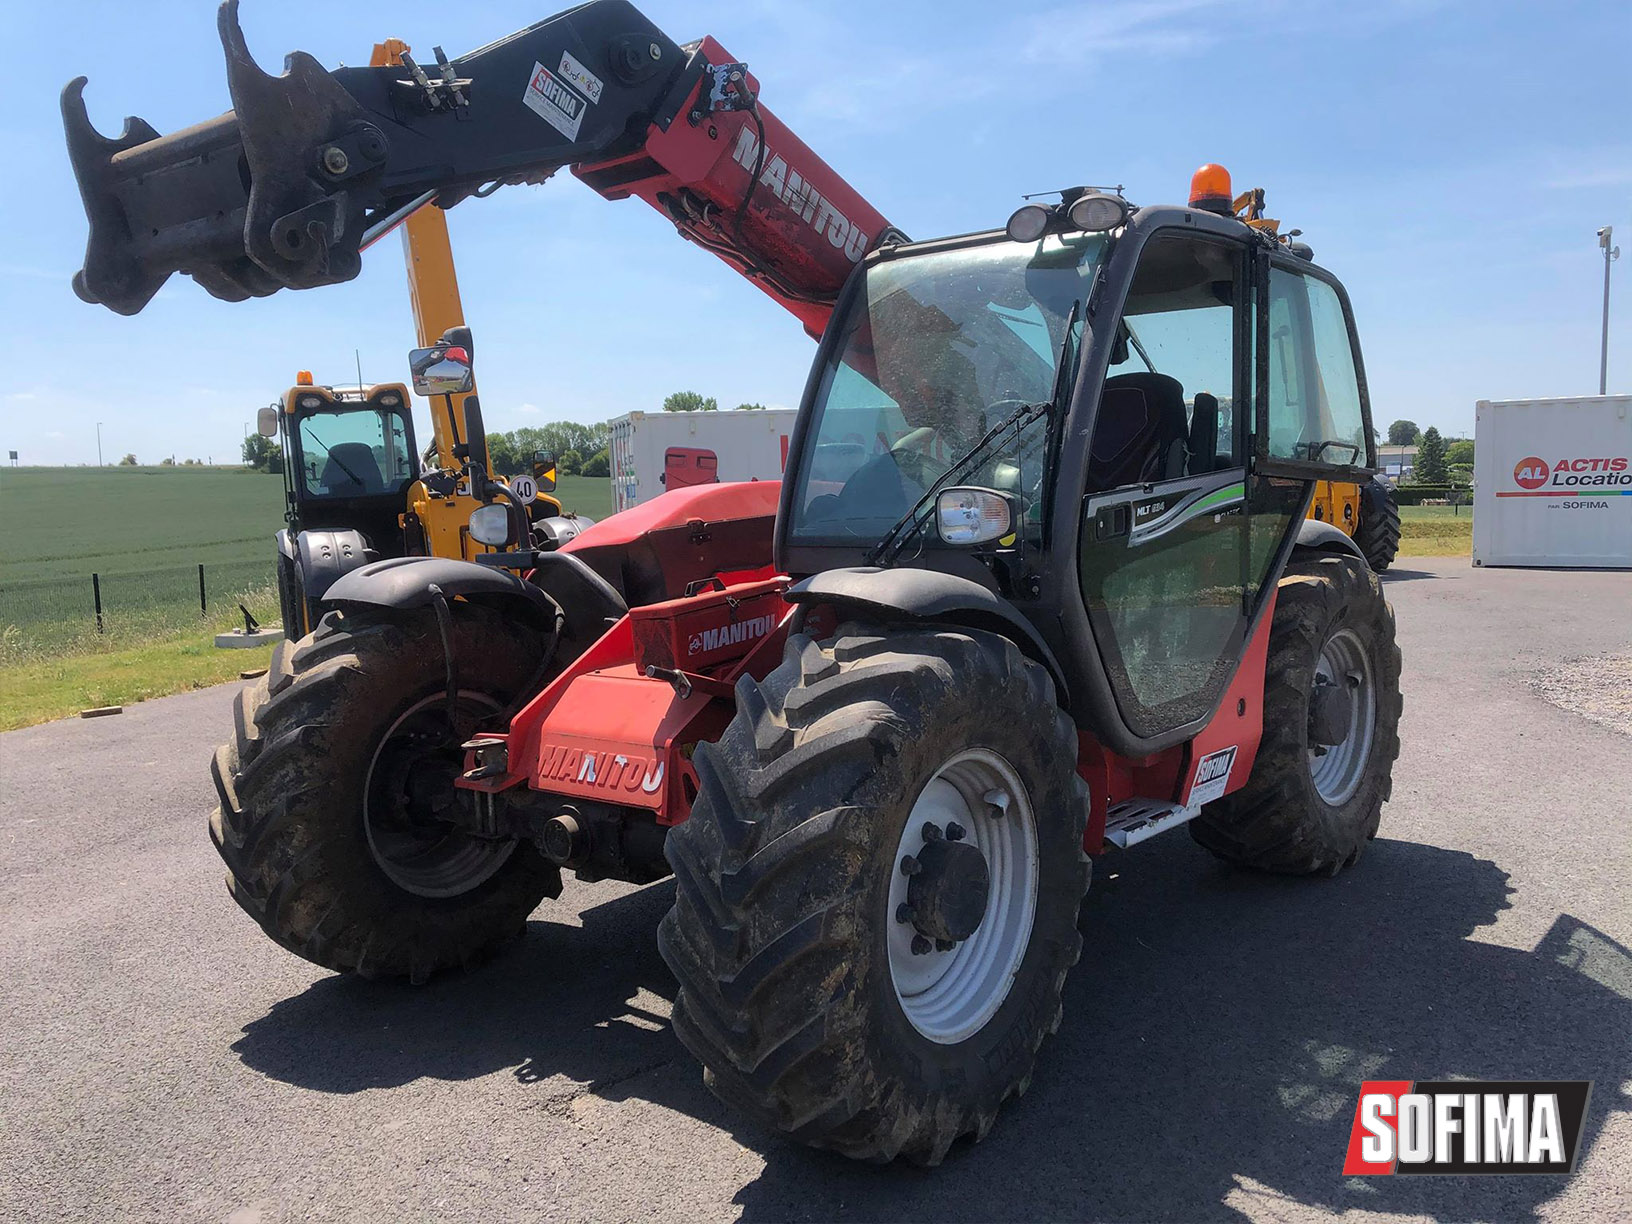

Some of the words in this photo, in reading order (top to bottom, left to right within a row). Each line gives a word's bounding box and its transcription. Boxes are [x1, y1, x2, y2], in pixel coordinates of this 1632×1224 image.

[535, 71, 577, 118] SOFIMA
[732, 126, 870, 264] MANITOU
[1517, 466, 1546, 480] AL
[1553, 457, 1629, 473] ACTIS
[1552, 472, 1632, 486] Locatio
[516, 481, 532, 498] 40
[1136, 504, 1151, 517] MLT
[1562, 501, 1609, 509] SOFIMA
[702, 614, 776, 652] MANITOU
[538, 744, 665, 792] MANITOU
[1197, 753, 1231, 783] SOFIMA
